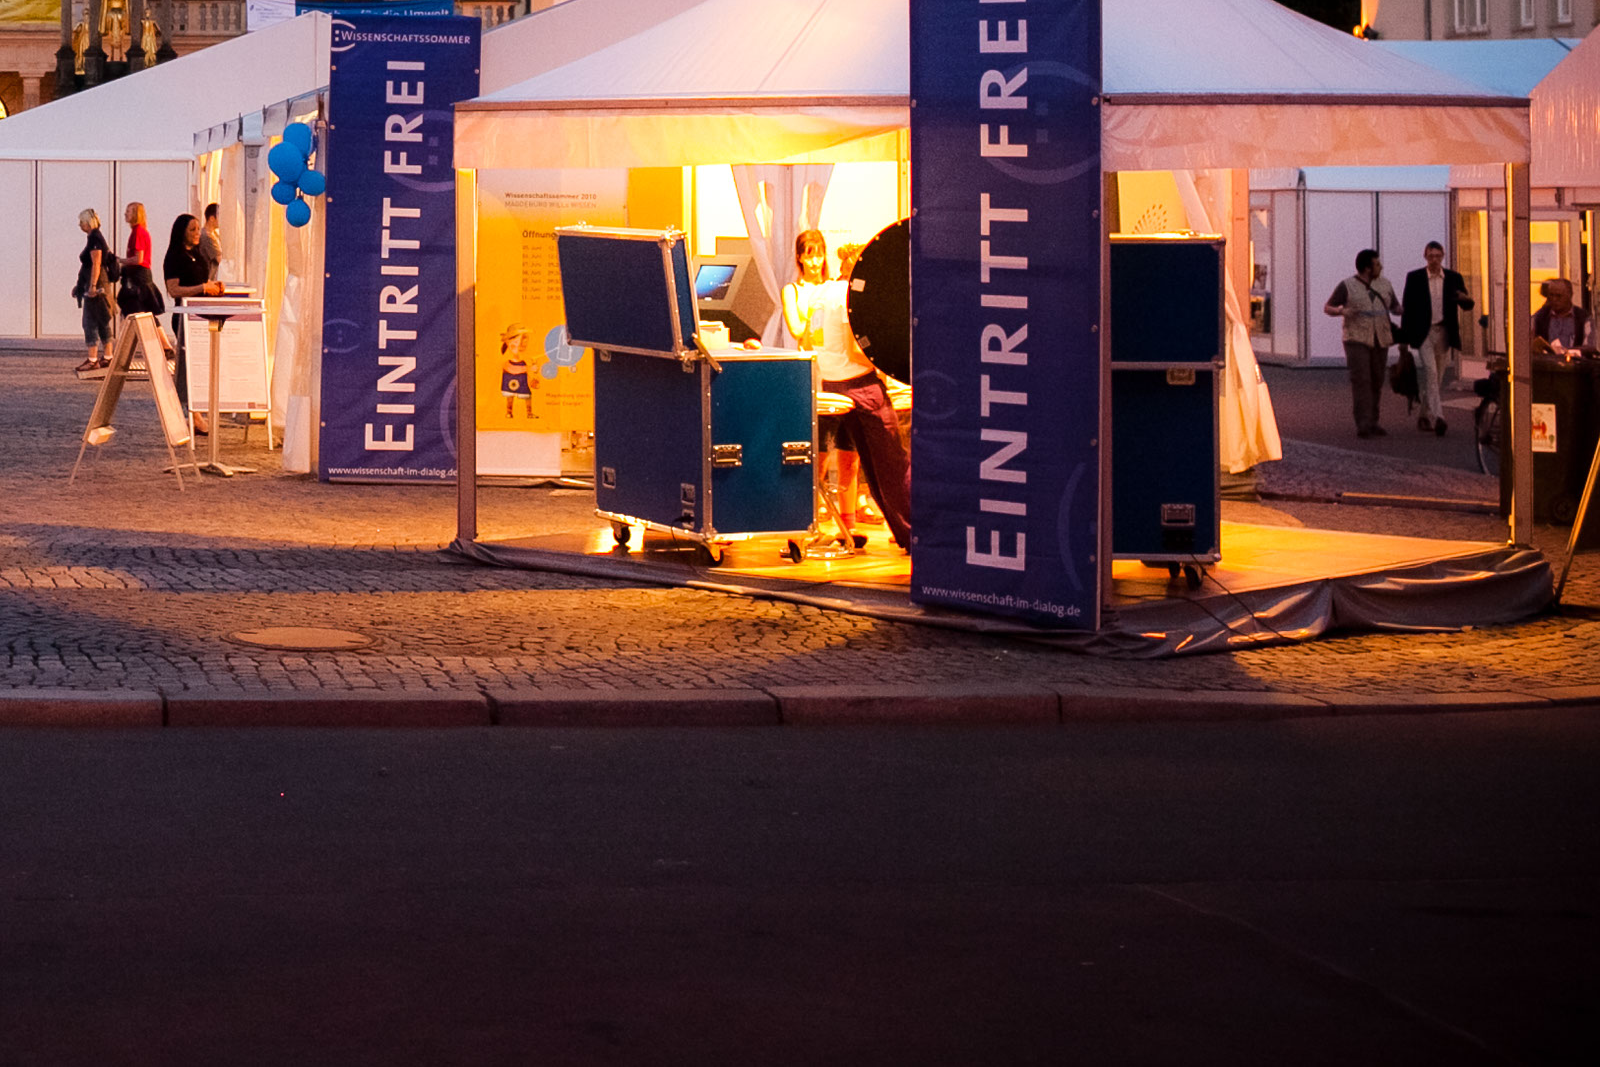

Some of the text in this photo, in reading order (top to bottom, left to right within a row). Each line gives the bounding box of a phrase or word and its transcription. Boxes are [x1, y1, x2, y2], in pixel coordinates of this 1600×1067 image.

[340, 30, 471, 44] WISSENSCHAFTSSOMMER
[364, 60, 425, 451] EINTRITT FREI
[966, 193, 1029, 571] EINTRITT
[328, 466, 458, 479] www.wissenschaft-im-dialog.de
[921, 586, 1081, 618] www.wissenschaft-im-dialog.de
